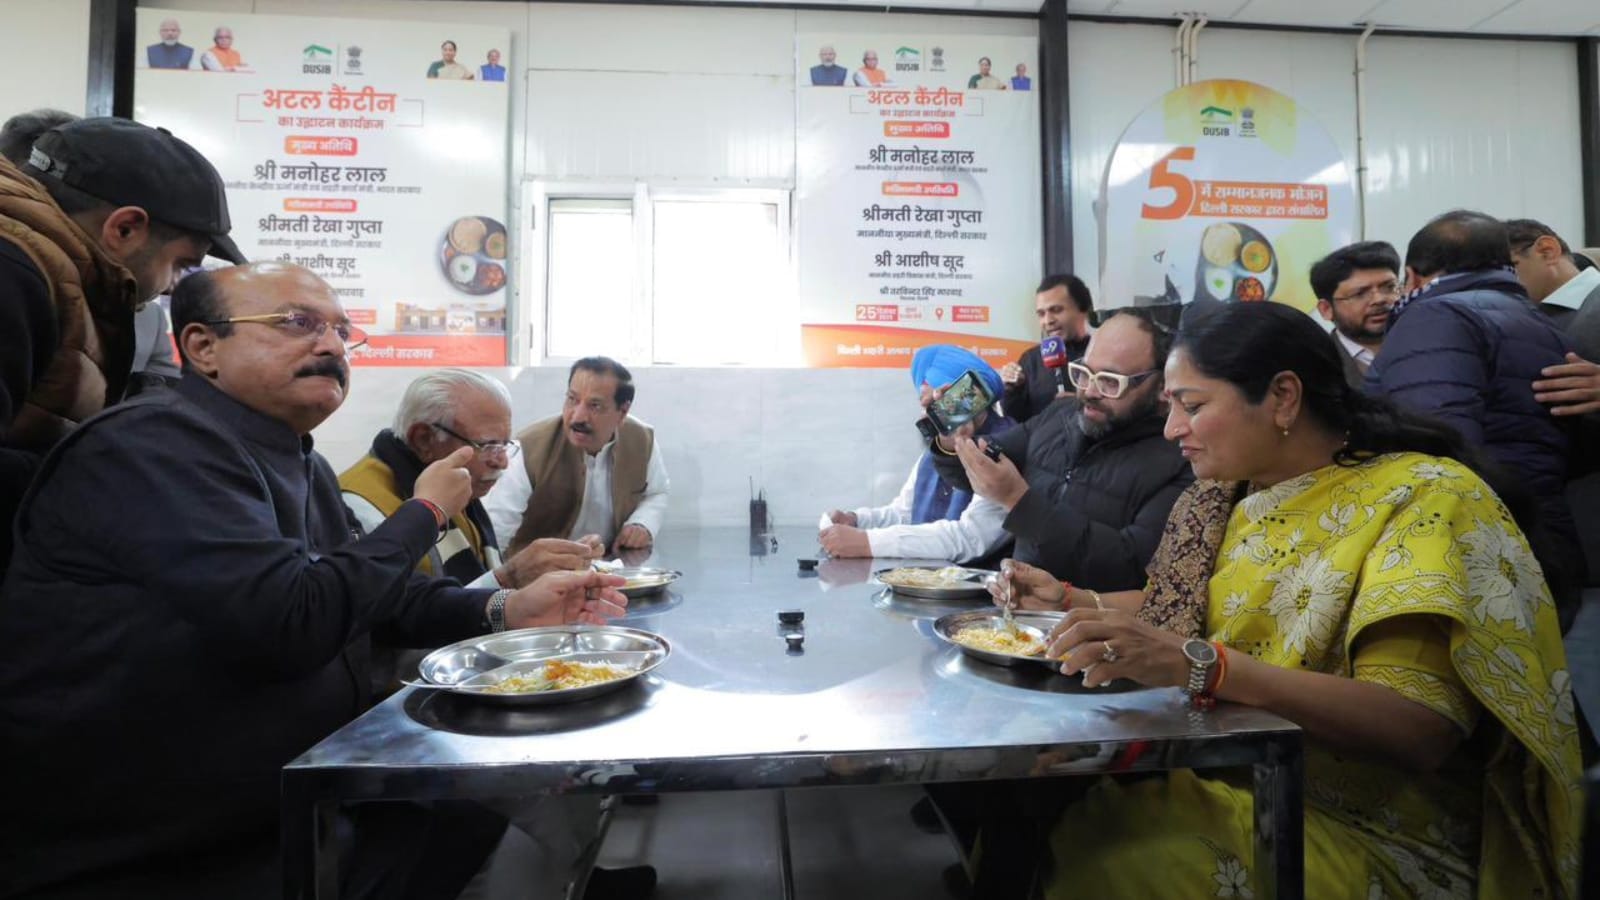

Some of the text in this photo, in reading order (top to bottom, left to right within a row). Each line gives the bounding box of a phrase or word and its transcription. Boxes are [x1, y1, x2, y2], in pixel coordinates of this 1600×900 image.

[303, 64, 331, 74] DUSIB
[262, 83, 398, 112] अटल कैंटीन
[868, 90, 911, 105] अटल
[880, 109, 892, 117] का
[278, 116, 293, 127] का
[338, 116, 384, 130] कार्यक्रम
[914, 123, 945, 133] अतिथि
[1203, 127, 1230, 136] DUSIB
[869, 144, 975, 165] श्री मनोहर लाल
[254, 160, 388, 184] श्री मनोहर लाल
[1141, 147, 1324, 220] 5 में सम्मानजनक भोजन
[862, 204, 983, 228] श्रीमती रेखा गुप्ता
[1200, 201, 1228, 214] दिल्ली
[1231, 204, 1262, 215] सरकार
[1266, 205, 1285, 216] द्वारा
[258, 214, 383, 239] श्रीमती रेखा गुप्ता
[934, 230, 959, 239] दिल्ली
[960, 231, 987, 241] सरकार
[336, 257, 357, 274] सूद
[874, 251, 965, 272] श्री आशीष सूद
[880, 286, 889, 295] श्री
[857, 306, 878, 320] 25
[397, 348, 436, 360] सरकार
